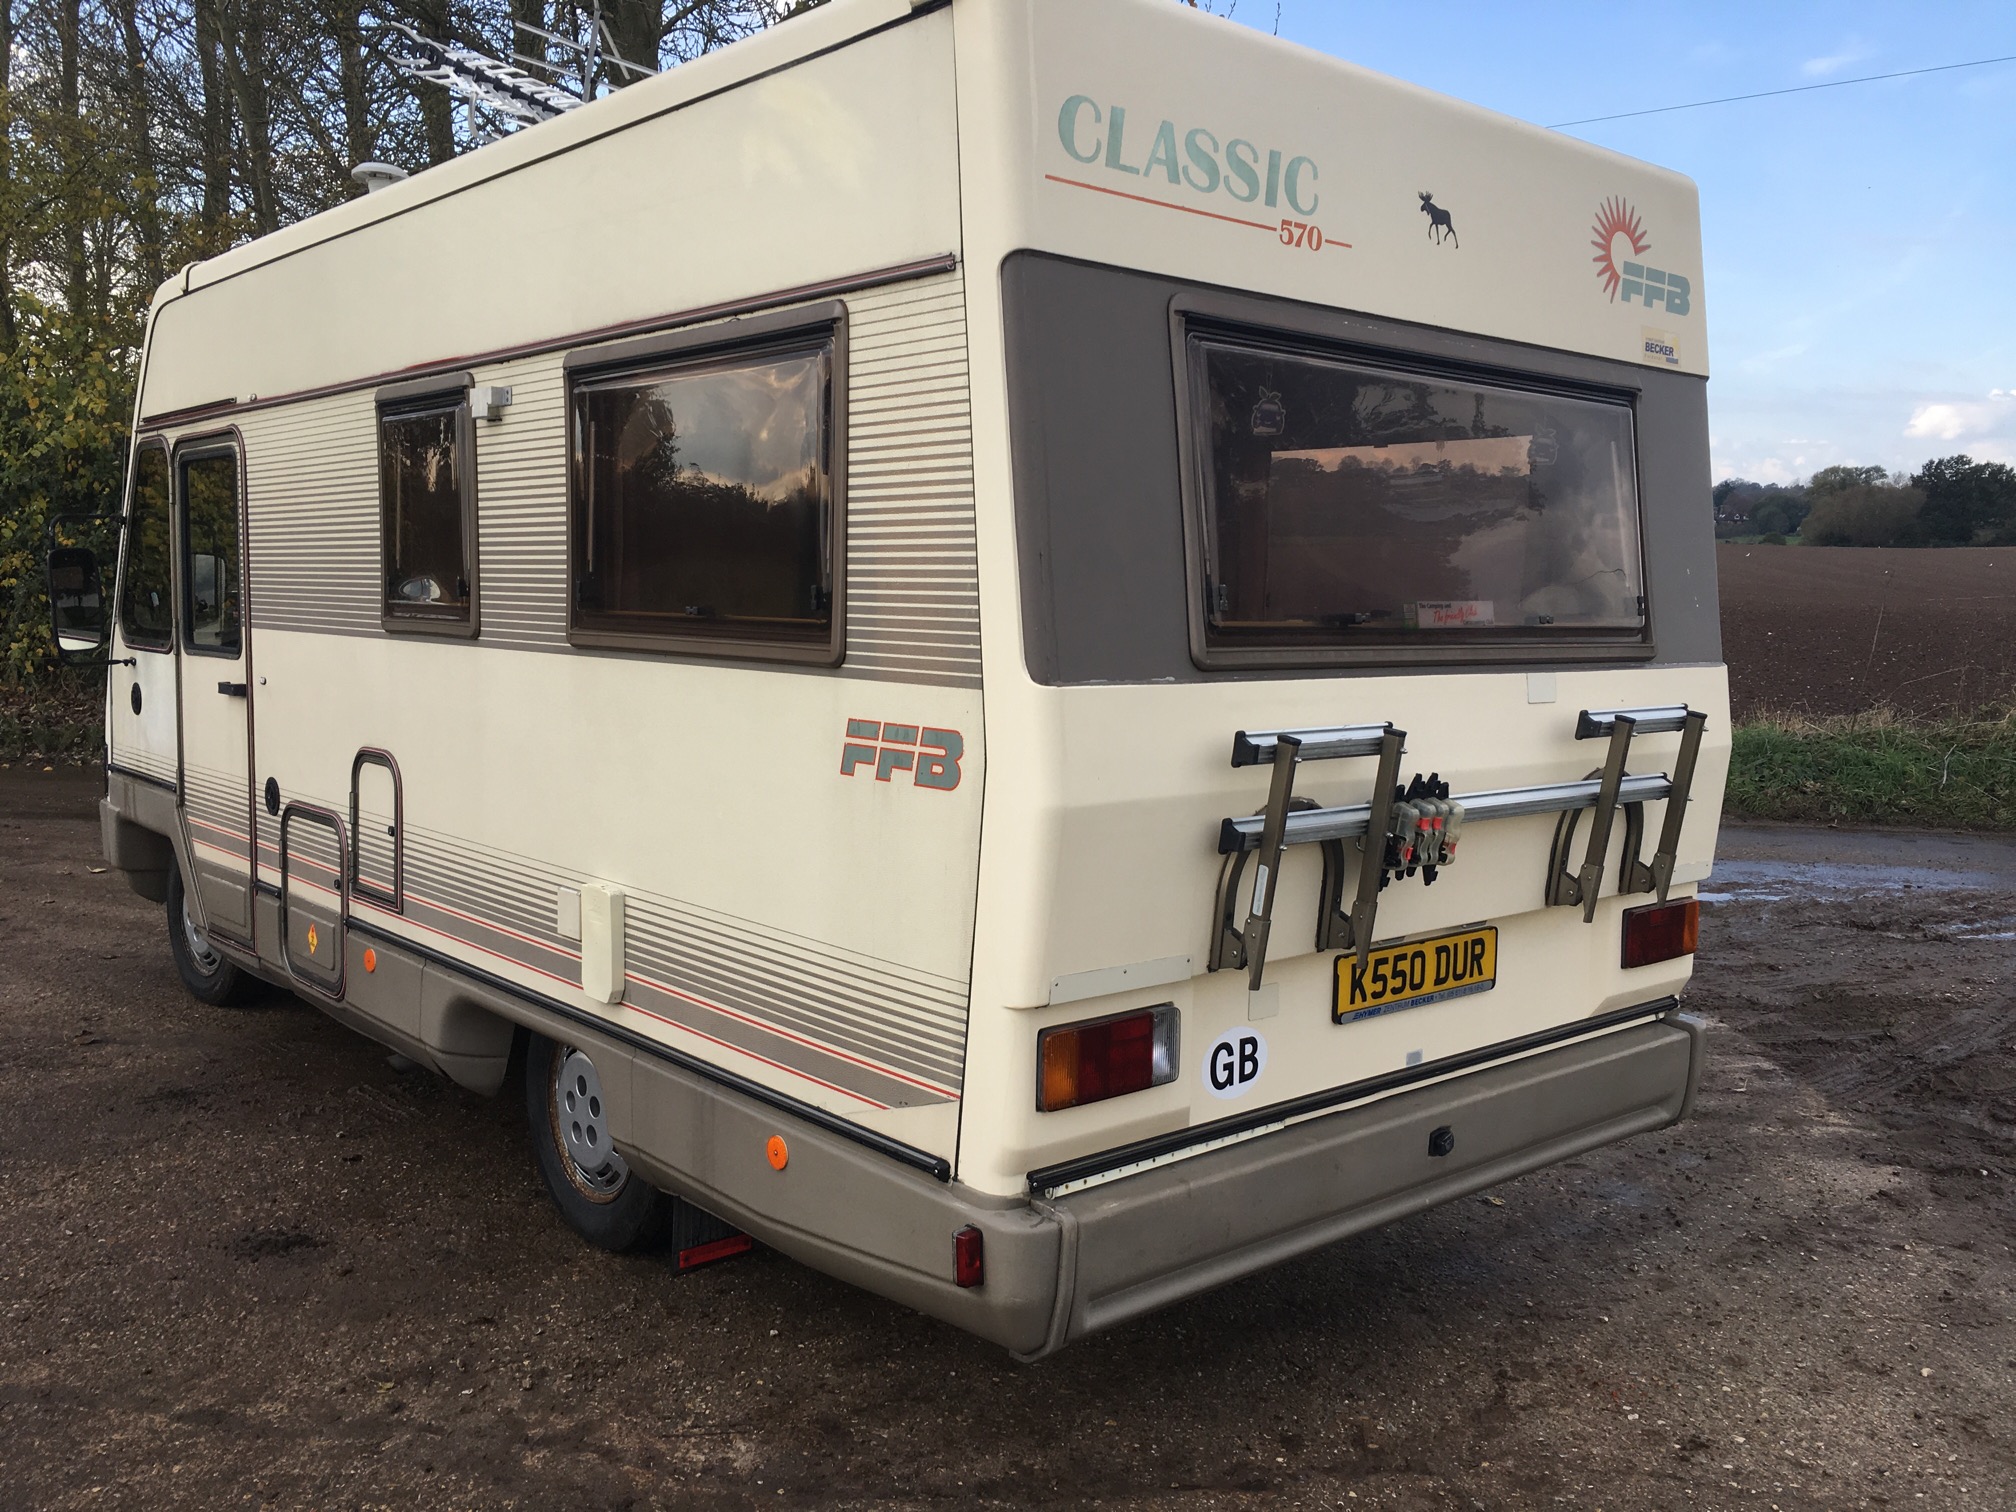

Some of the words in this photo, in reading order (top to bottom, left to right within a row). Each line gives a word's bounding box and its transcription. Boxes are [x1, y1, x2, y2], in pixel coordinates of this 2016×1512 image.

[1058, 94, 1319, 216] CLASSIC
[1279, 218, 1323, 251] 570
[1621, 260, 1691, 317] FFB
[1645, 341, 1674, 357] BECKER
[840, 717, 964, 792] FFB
[1349, 950, 1425, 1005] K550
[1434, 937, 1486, 987] DUR
[1353, 1007, 1382, 1020] HYMER
[1410, 994, 1434, 1007] BECKER
[1210, 1035, 1259, 1091] GB
